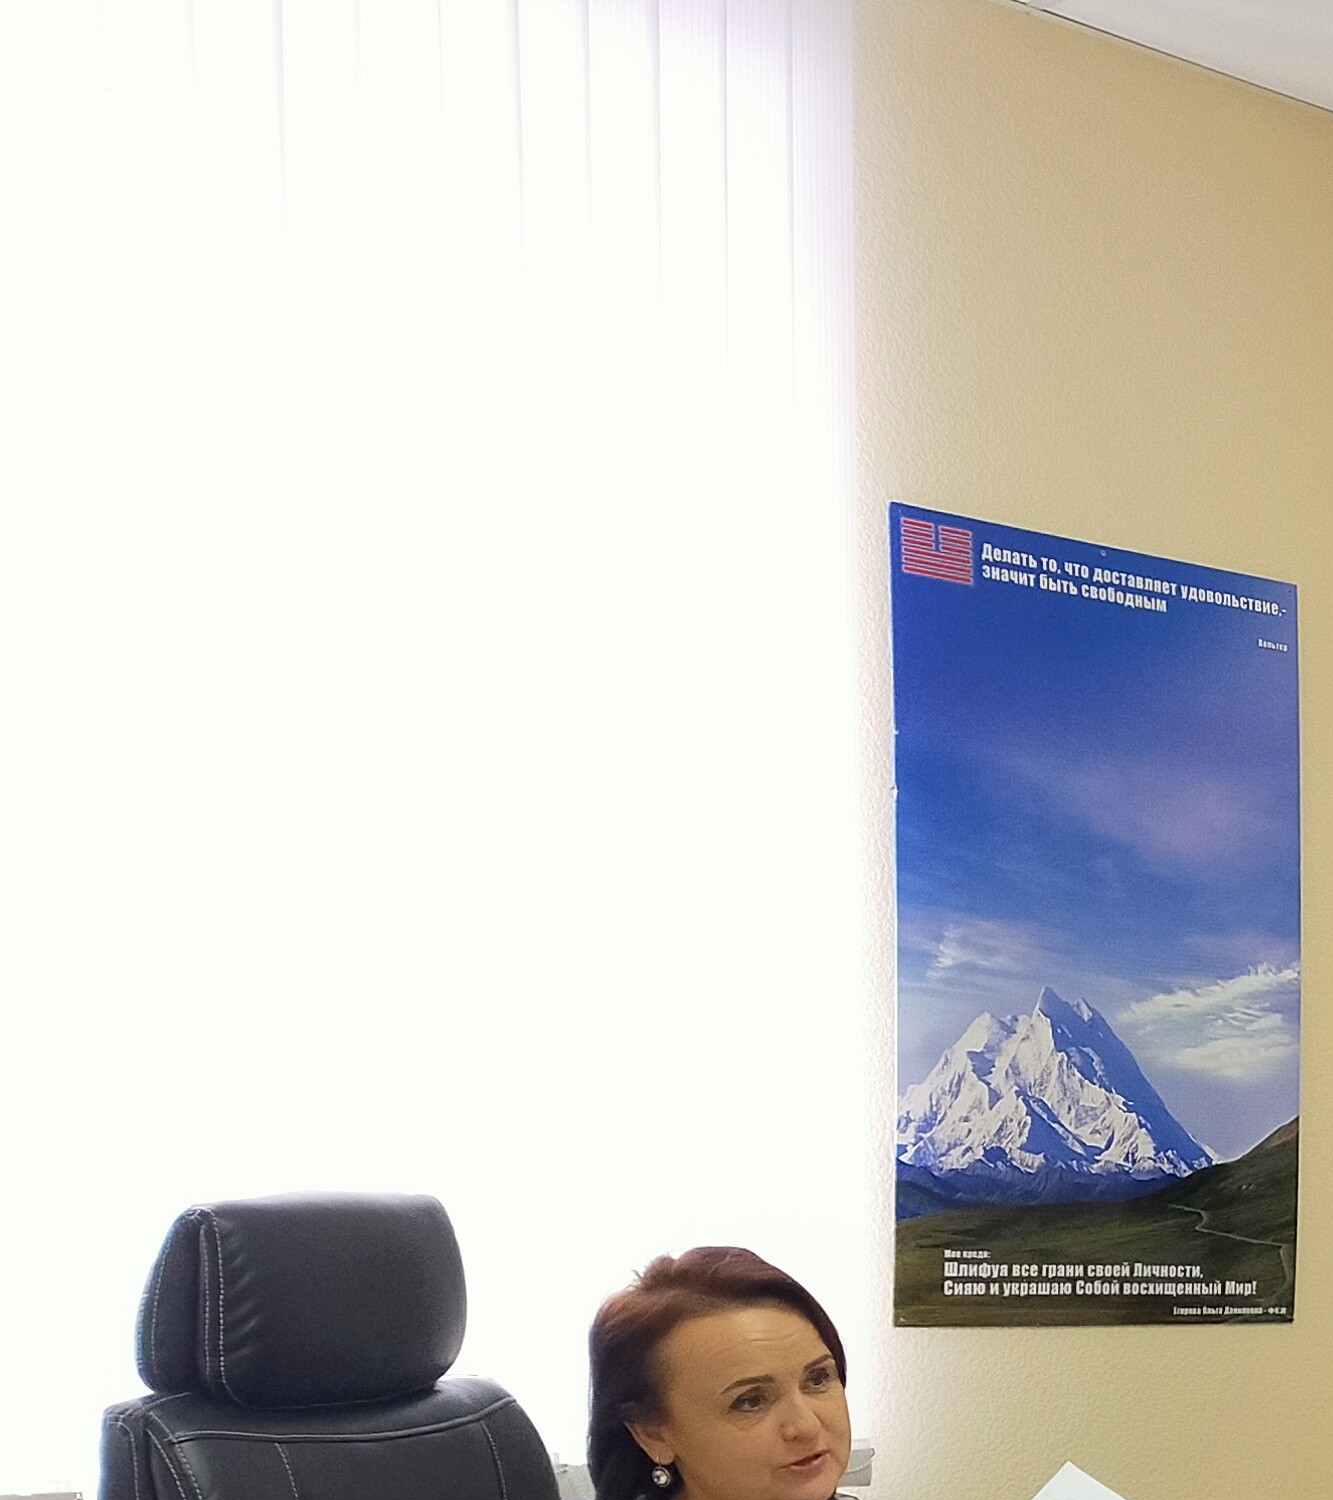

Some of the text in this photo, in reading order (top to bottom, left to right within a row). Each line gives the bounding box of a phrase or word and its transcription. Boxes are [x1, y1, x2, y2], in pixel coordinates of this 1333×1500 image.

[981, 543, 1287, 617] Делать то, что доставляет удовольствие,-
[981, 565, 1167, 613] значит быть свободным
[943, 1261, 1204, 1279] Шлифуя все грани своей Личности,
[943, 1279, 1257, 1297] Сияю и украшаю Собой восхищенный Мир!
